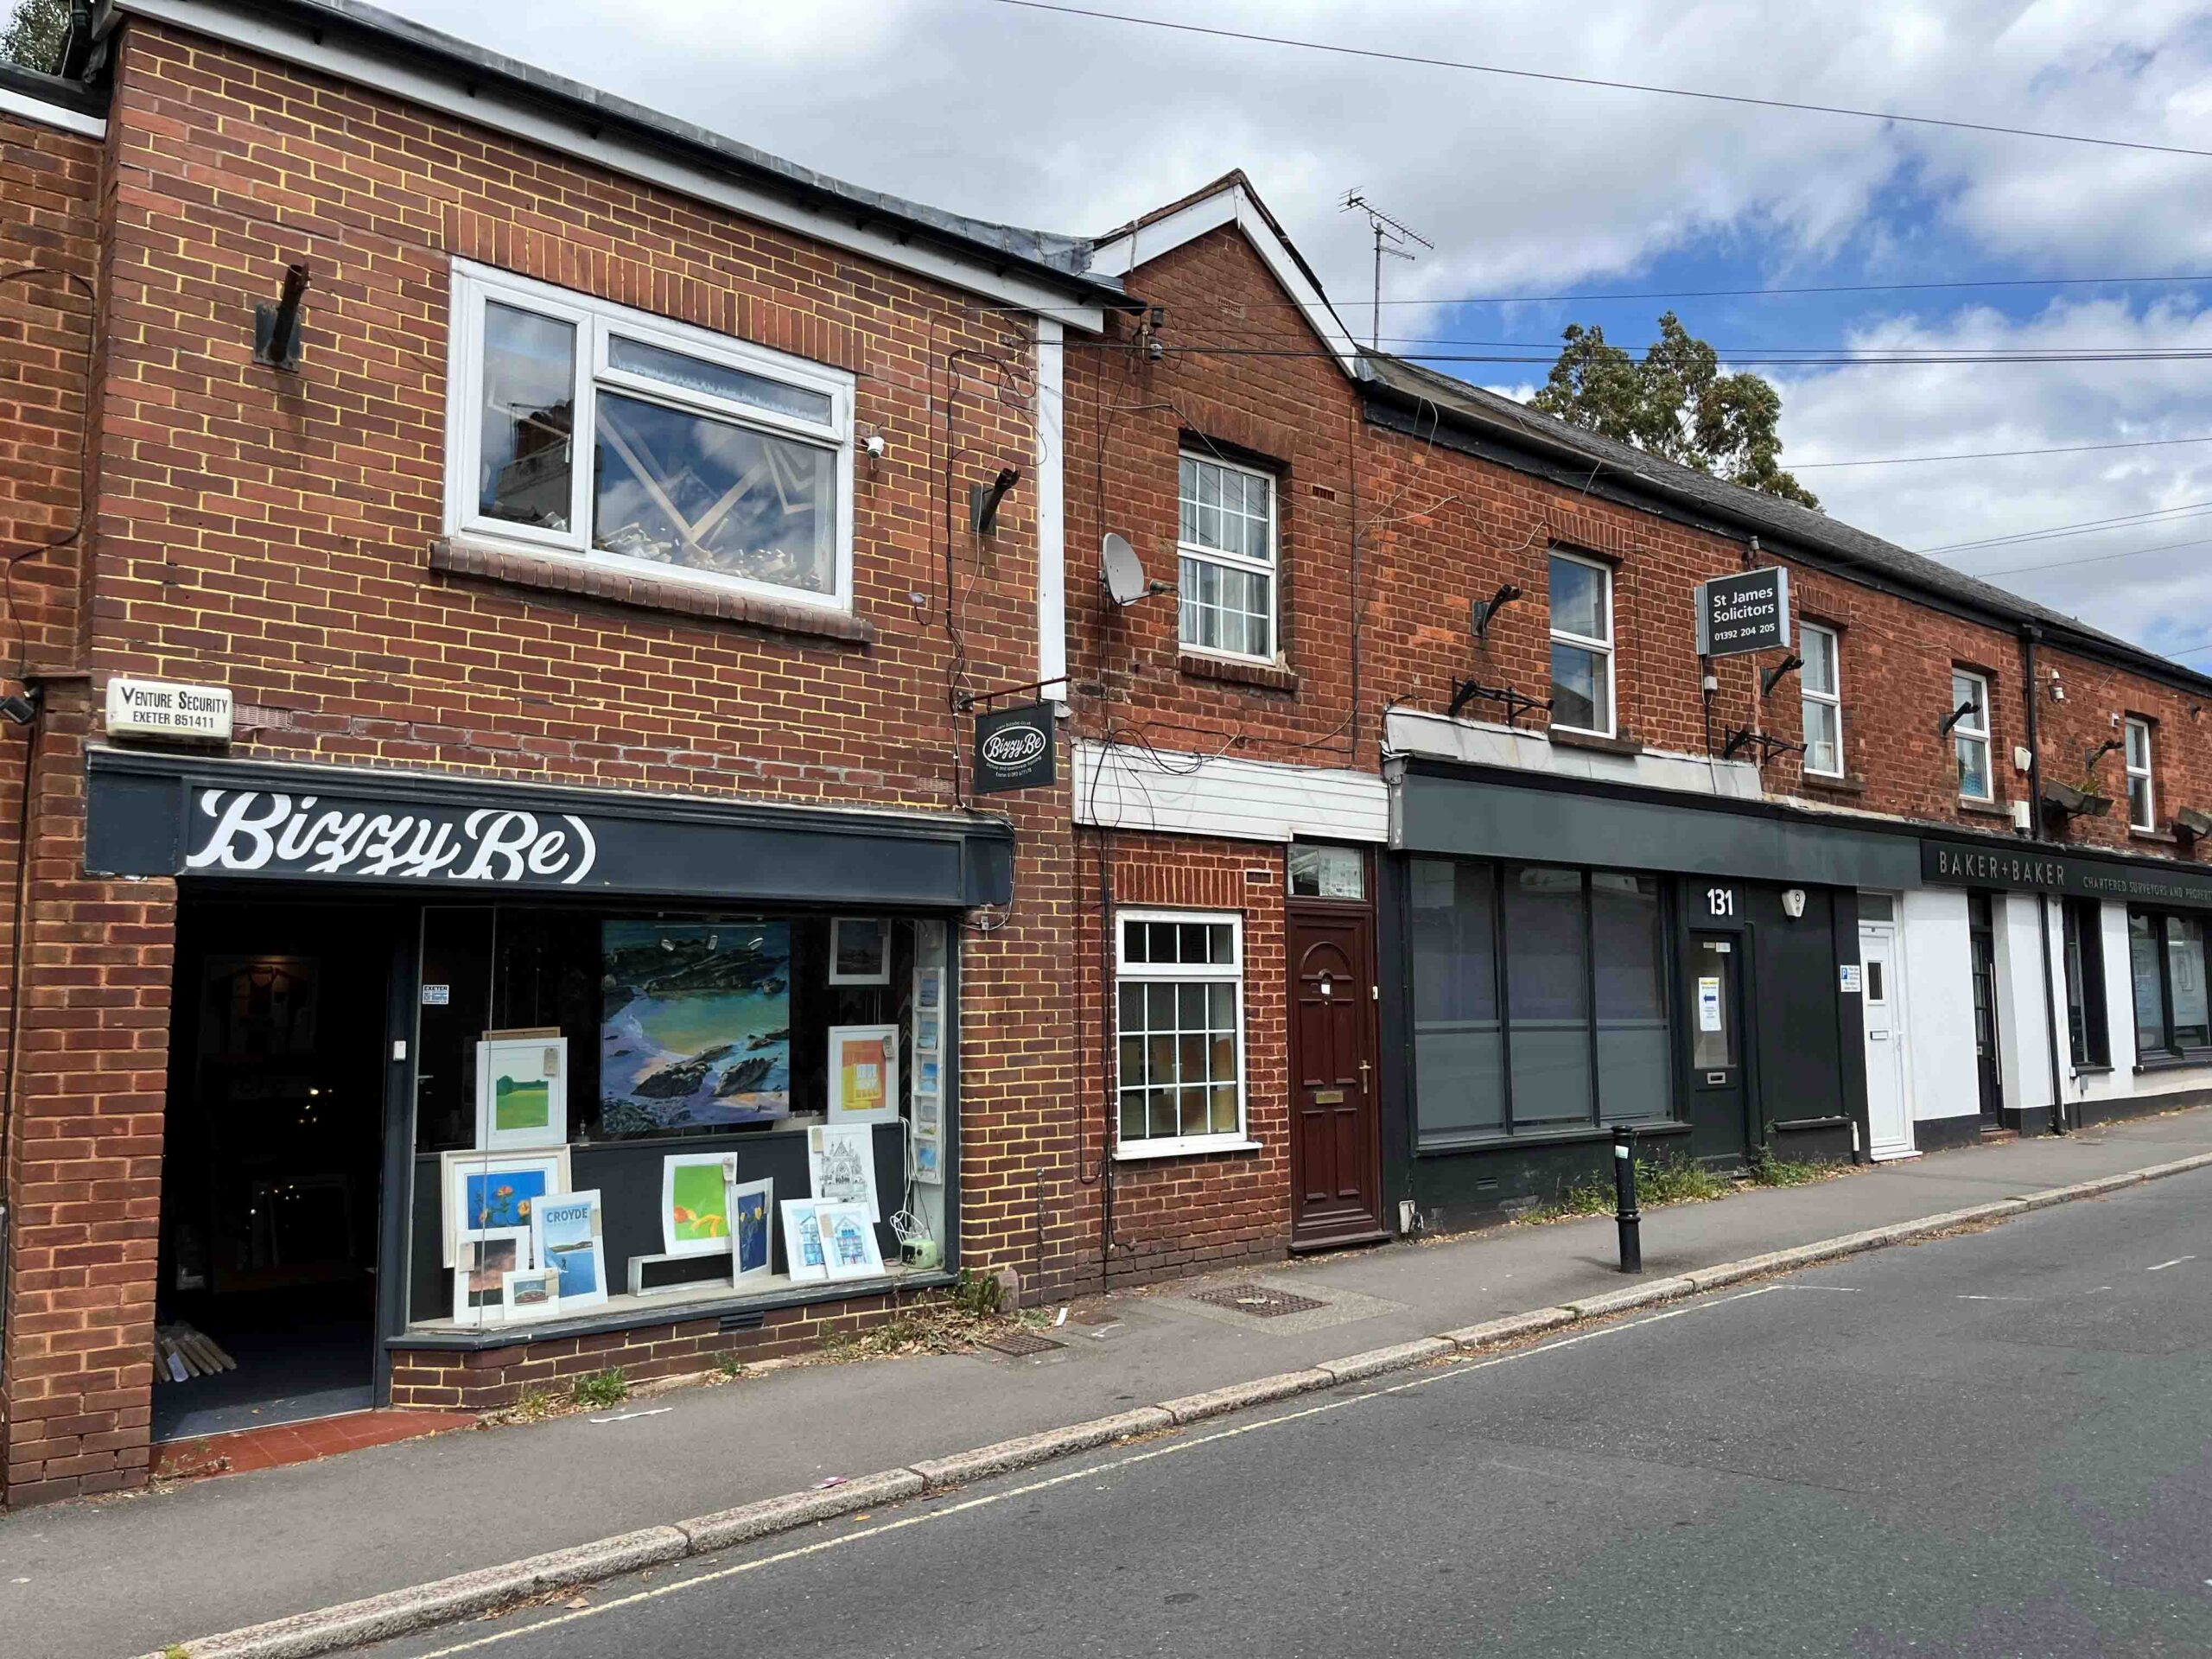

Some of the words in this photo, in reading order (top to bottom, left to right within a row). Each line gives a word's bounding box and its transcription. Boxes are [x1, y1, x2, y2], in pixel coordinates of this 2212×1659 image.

[1713, 594, 1726, 607] St
[1732, 588, 1773, 605] James
[1713, 603, 1775, 623] Solicitors
[1714, 630, 1738, 641] 01392
[1740, 626, 1756, 637] 204
[1759, 623, 1775, 633] 205
[121, 686, 173, 709] VENTURE
[179, 691, 228, 714] SECURITY
[133, 710, 170, 725] EXETER
[175, 714, 214, 728] 851411
[988, 736, 1023, 760] Bizzy
[1022, 733, 1041, 754] Be
[1939, 850, 2065, 886] BAKER+BAKER
[2082, 875, 2127, 892] CHARTERED
[2129, 881, 2167, 896] SURVEYORS
[2169, 887, 2183, 899] AND
[1707, 888, 1733, 916] 131
[546, 1207, 588, 1224] CROYDE
